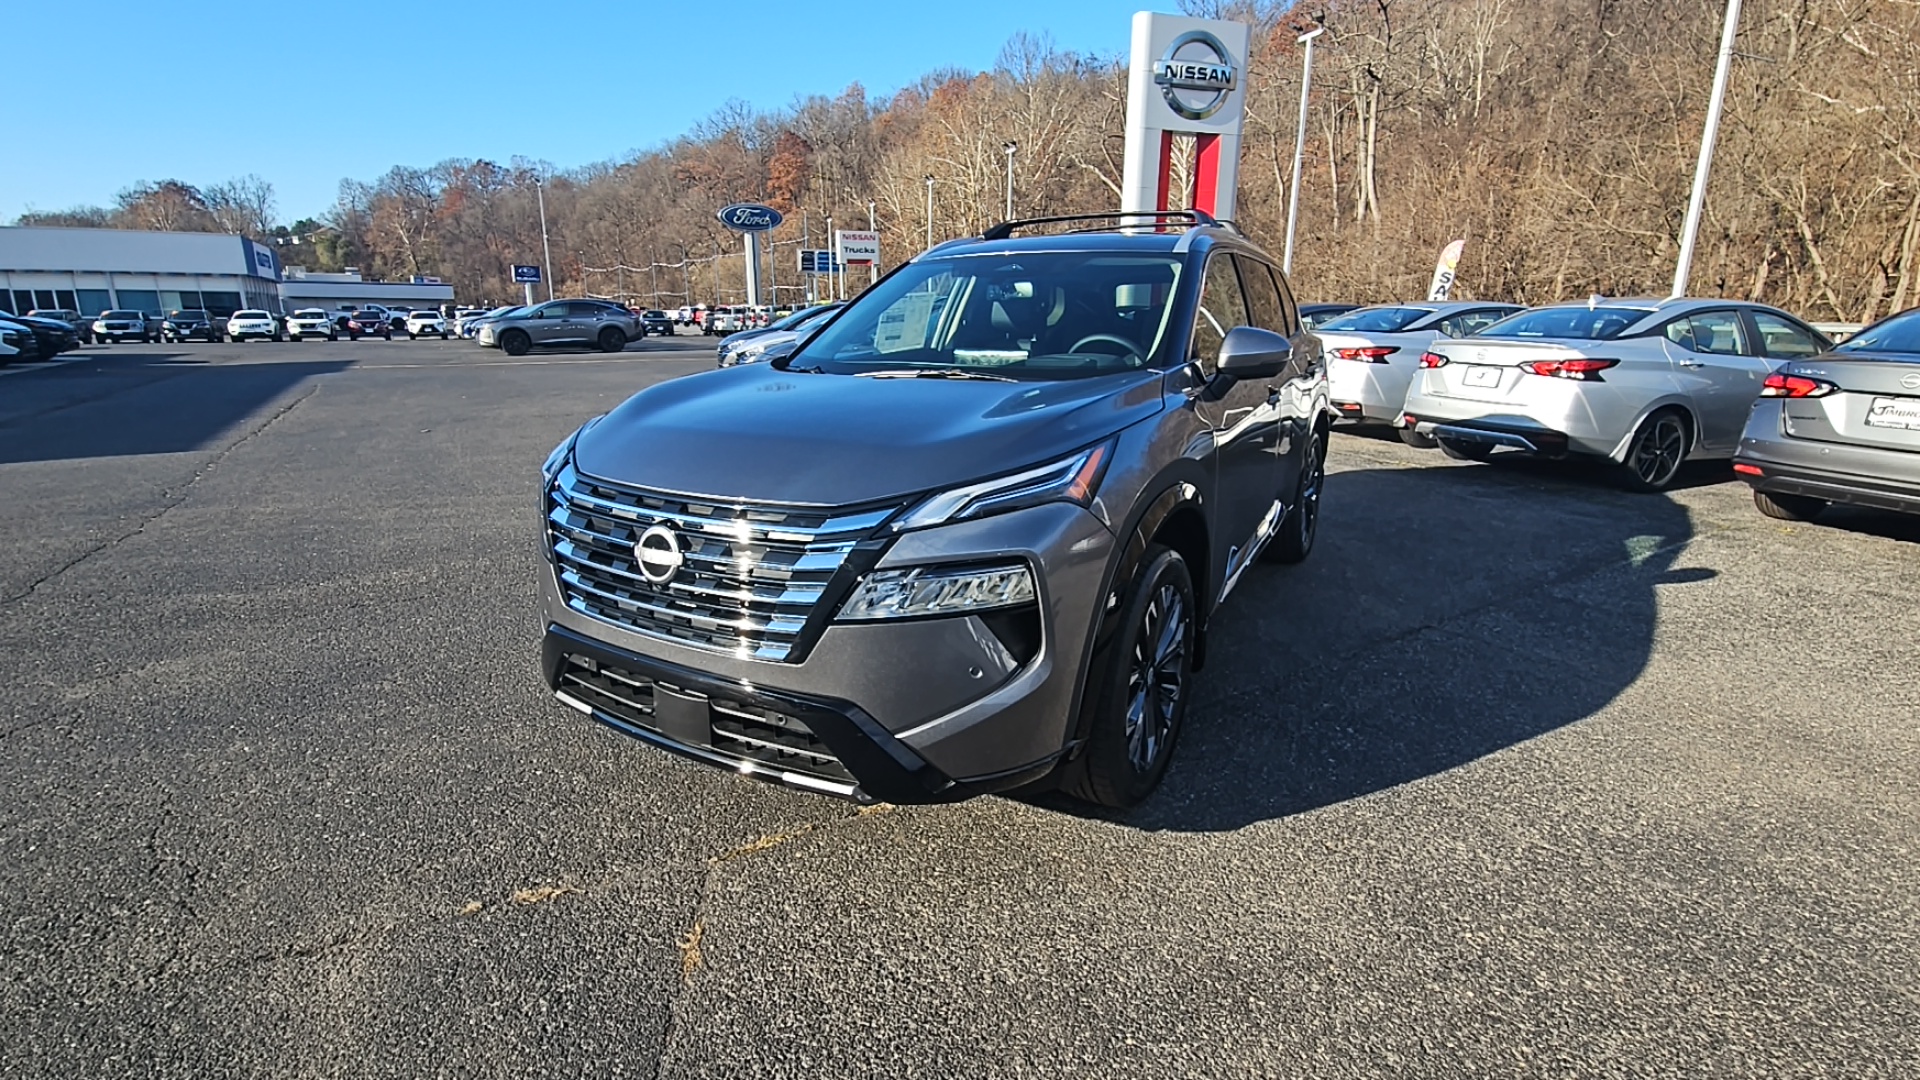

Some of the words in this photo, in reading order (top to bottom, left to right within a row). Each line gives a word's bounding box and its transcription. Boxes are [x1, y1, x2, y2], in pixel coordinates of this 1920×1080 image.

[1164, 64, 1232, 84] NISSAN
[732, 208, 771, 225] Ford
[842, 233, 876, 241] NISSAN
[844, 246, 876, 254] Trucks
[1434, 271, 1453, 300] SA
